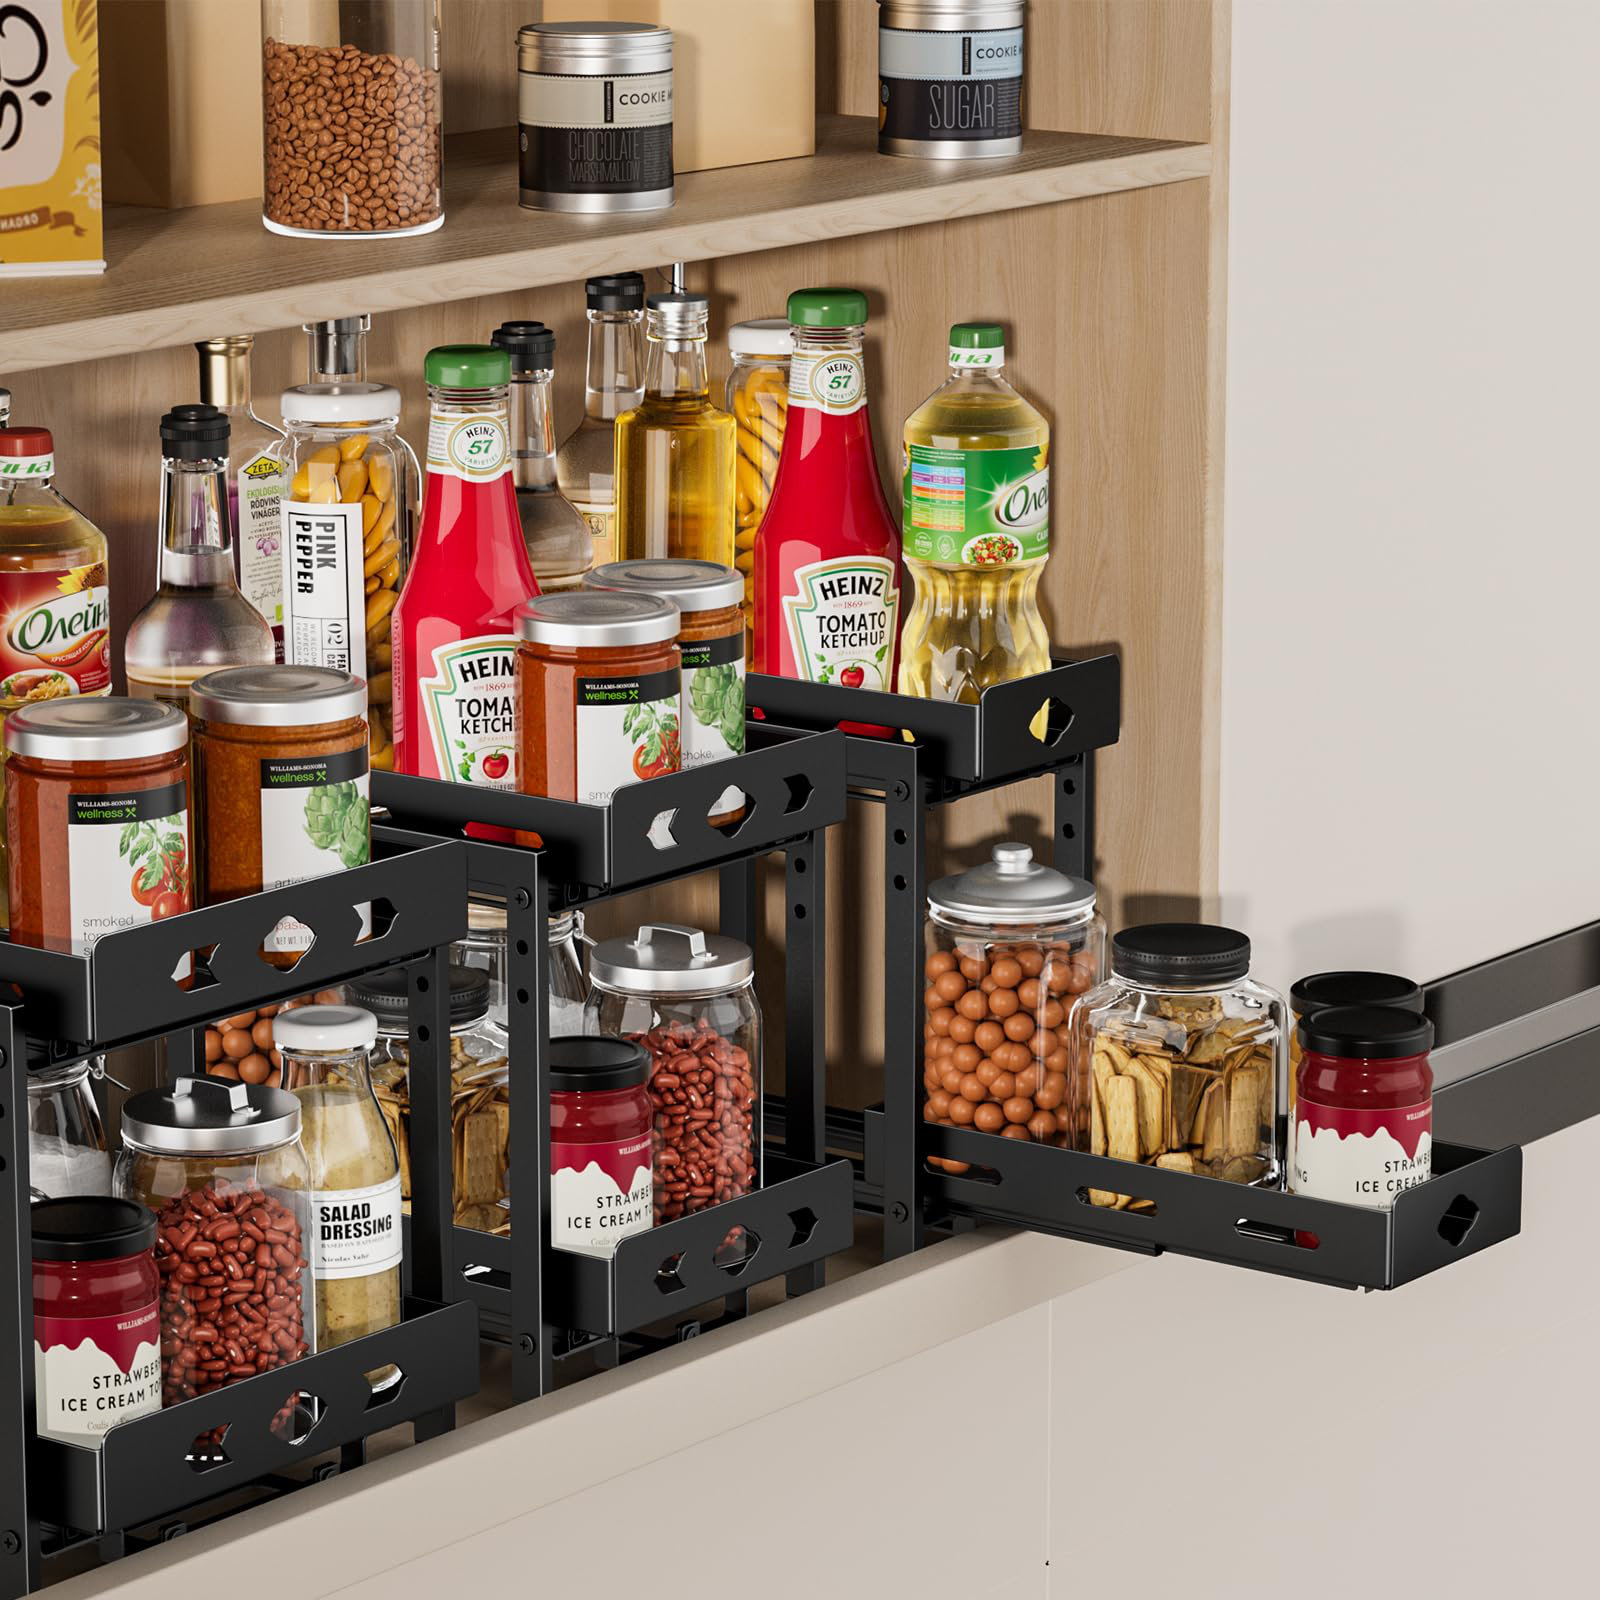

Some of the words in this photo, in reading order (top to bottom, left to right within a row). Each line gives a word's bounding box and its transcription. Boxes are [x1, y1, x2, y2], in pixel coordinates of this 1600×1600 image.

[976, 45, 1017, 59] COOKIE
[619, 90, 666, 106] COOKIE
[929, 84, 995, 129] SUGAR
[568, 129, 641, 162] CHOCOLATE
[568, 160, 641, 183] MARSHMALLOW
[826, 362, 854, 374] HEINZ
[828, 374, 852, 390] 57
[465, 426, 496, 439] HEINZ
[467, 439, 494, 455] 57
[252, 463, 275, 474] ZETA
[316, 521, 336, 570] PINK
[295, 520, 314, 594] PEPPER
[820, 576, 884, 600] HEINZ
[18, 598, 108, 651] Олейн
[816, 611, 887, 633] TOMATO
[821, 630, 885, 649] KETCHUP
[459, 656, 515, 683] HEIN
[585, 691, 627, 701] wellness
[455, 696, 516, 718] TOMA
[461, 716, 513, 735] KETCH
[270, 772, 315, 783] wellness
[77, 800, 137, 808] WILLIAMS-SONOMA
[77, 808, 124, 819] wellness
[82, 914, 134, 928] smoked
[1356, 1180, 1379, 1193] ICE
[320, 1203, 370, 1223] SALAD
[568, 1216, 592, 1229] ICE
[599, 1208, 641, 1228] CREAM
[321, 1214, 392, 1241] DRESSING
[61, 1398, 88, 1412] ICE
[96, 1389, 145, 1411] CREAM
